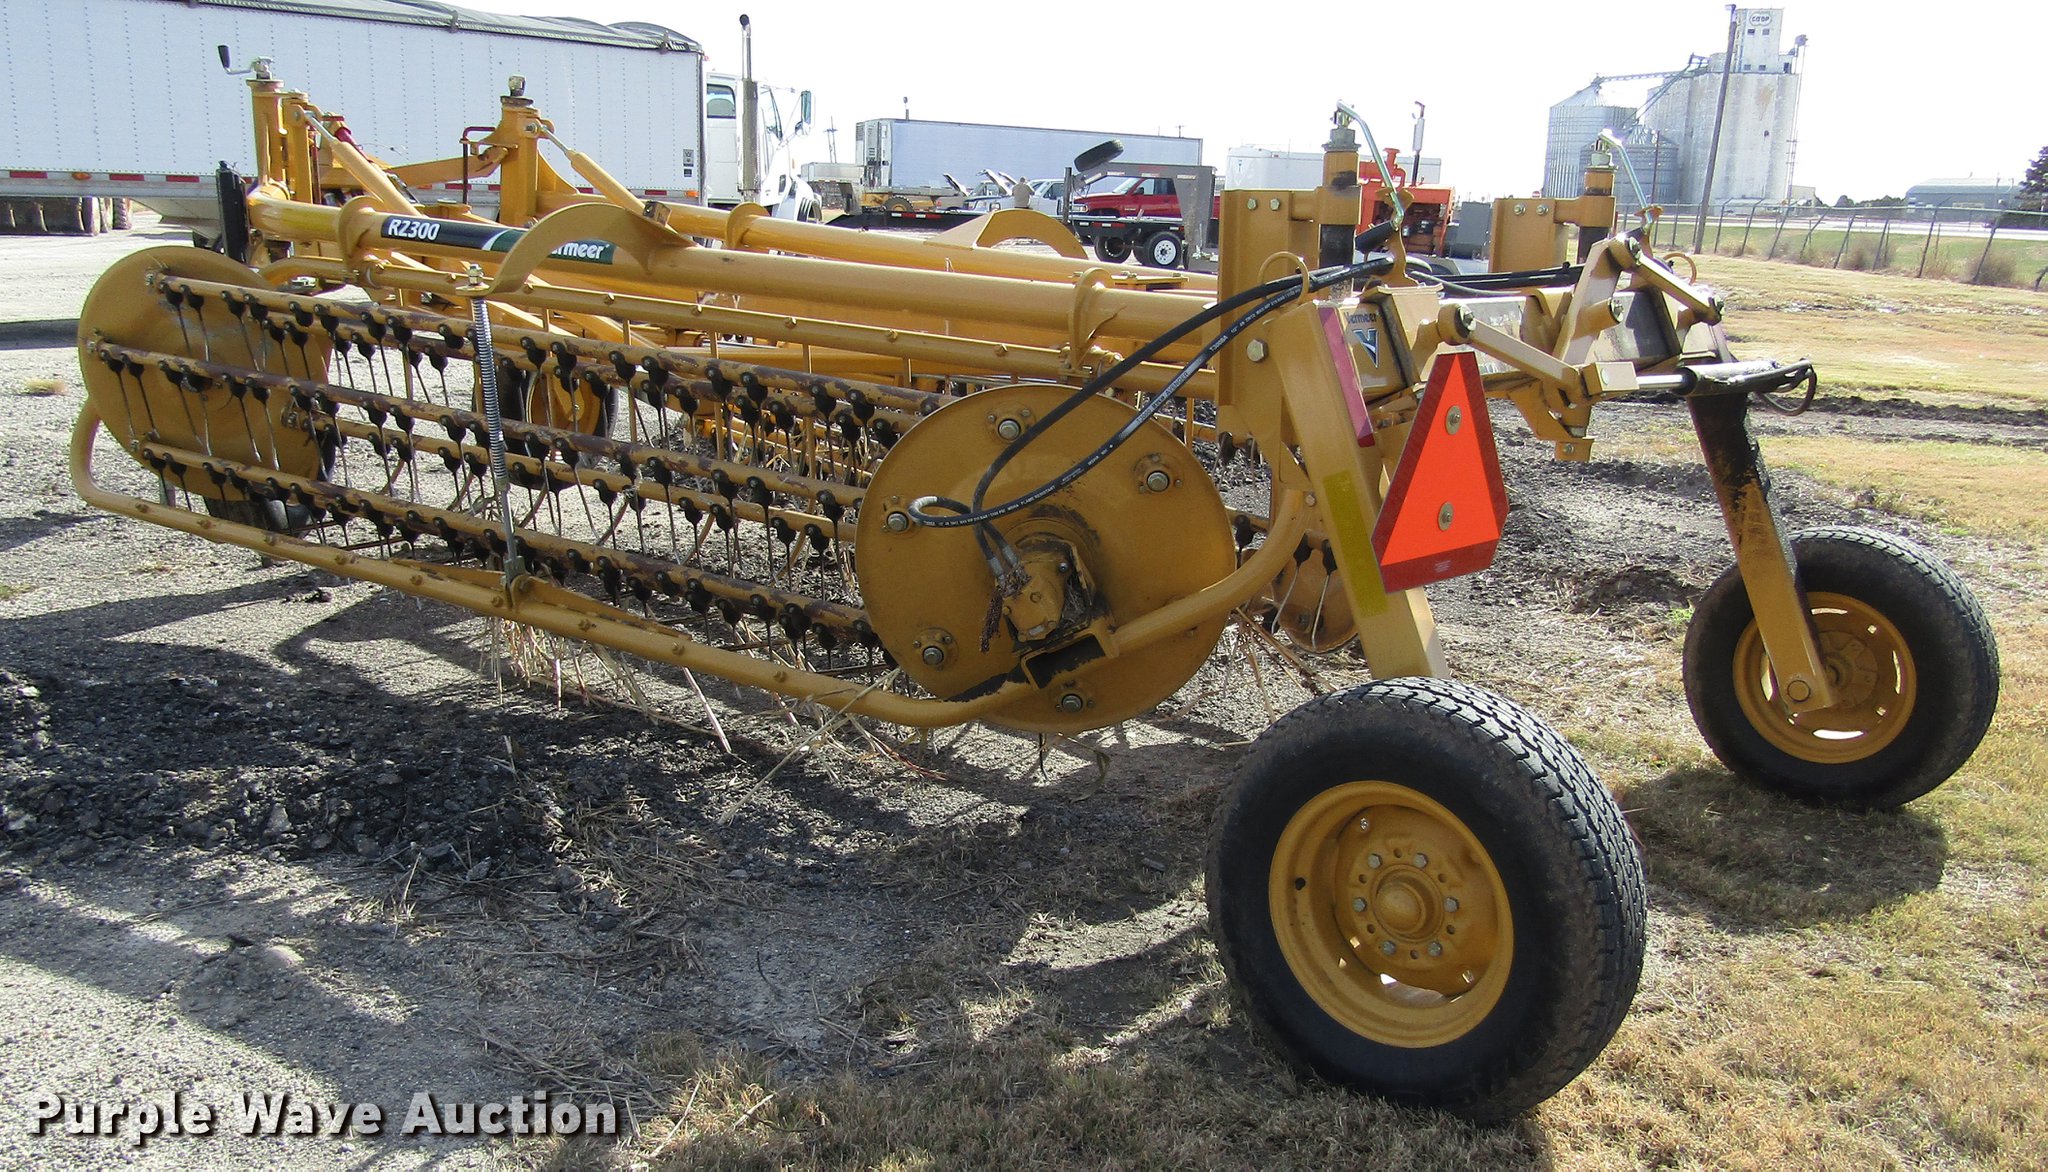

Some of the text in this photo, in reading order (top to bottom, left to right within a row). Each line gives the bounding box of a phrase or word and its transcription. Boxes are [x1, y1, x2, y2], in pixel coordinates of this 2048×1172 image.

[388, 218, 440, 241] RZ300
[1165, 371, 1189, 396] AVENGER
[1020, 497, 1034, 506] FLAME
